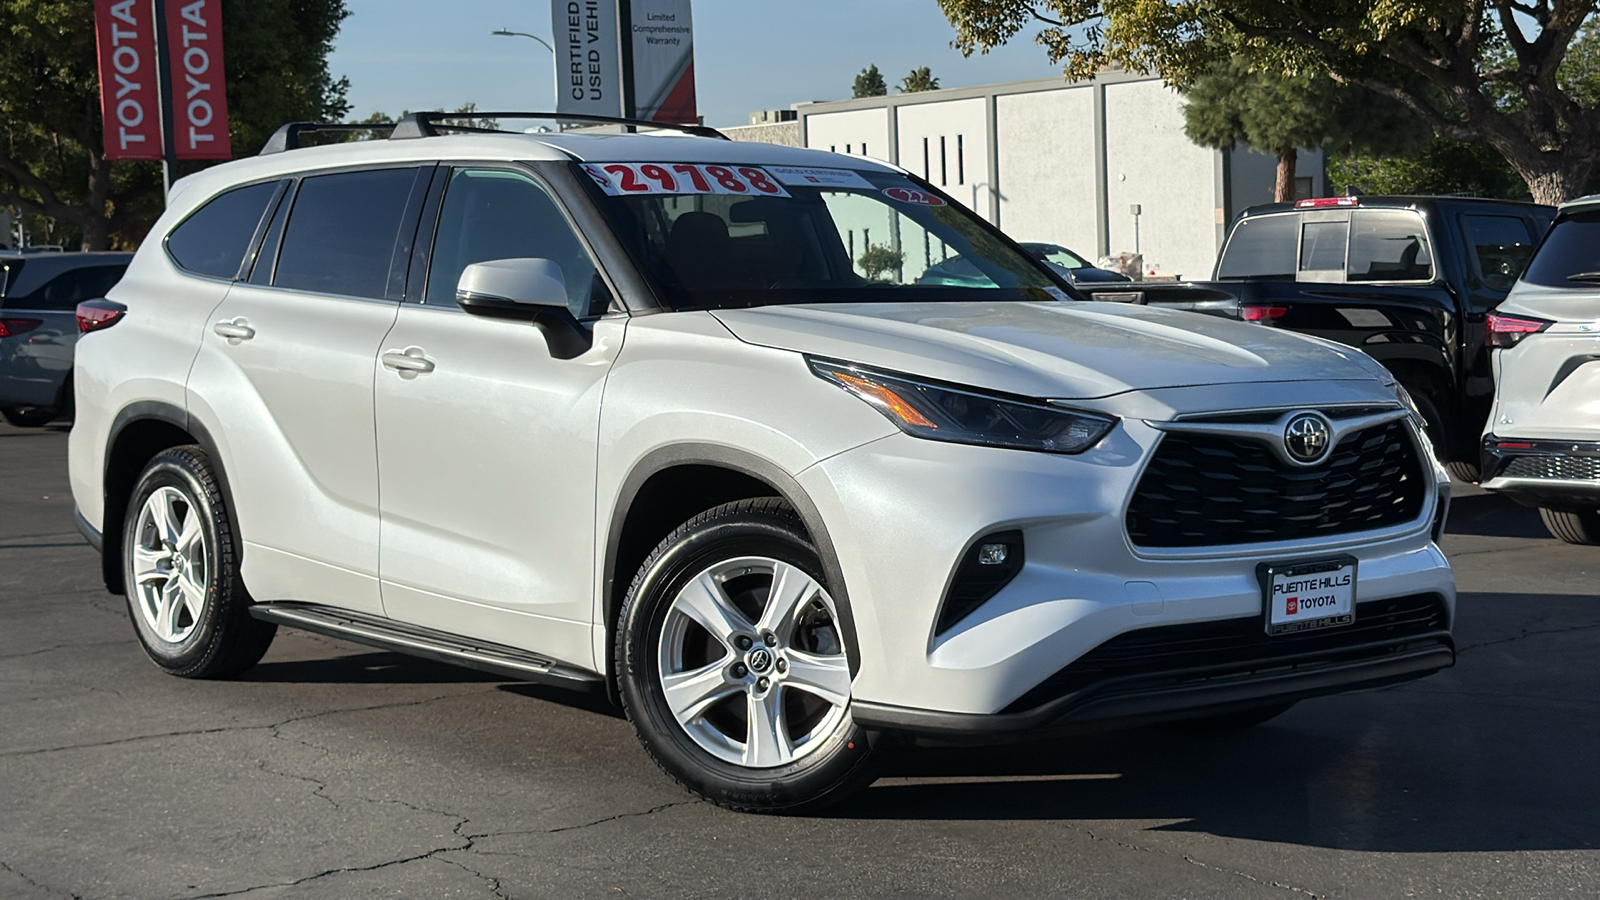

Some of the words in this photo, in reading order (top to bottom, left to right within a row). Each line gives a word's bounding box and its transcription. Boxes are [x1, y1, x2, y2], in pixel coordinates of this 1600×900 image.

[647, 13, 676, 21] Limited
[632, 24, 691, 34] Comprehensive
[646, 36, 681, 47] Warranty
[567, 2, 584, 101] CERTIFIED
[110, 0, 146, 150] TOYOTA
[181, 0, 214, 149] TOYOTA
[588, 50, 602, 101] USED
[899, 189, 930, 204] 22
[1273, 579, 1317, 595] PUENTE
[1319, 575, 1350, 589] HILLS
[1299, 595, 1336, 610] TOYOTA
[1319, 615, 1351, 627] HILLS
